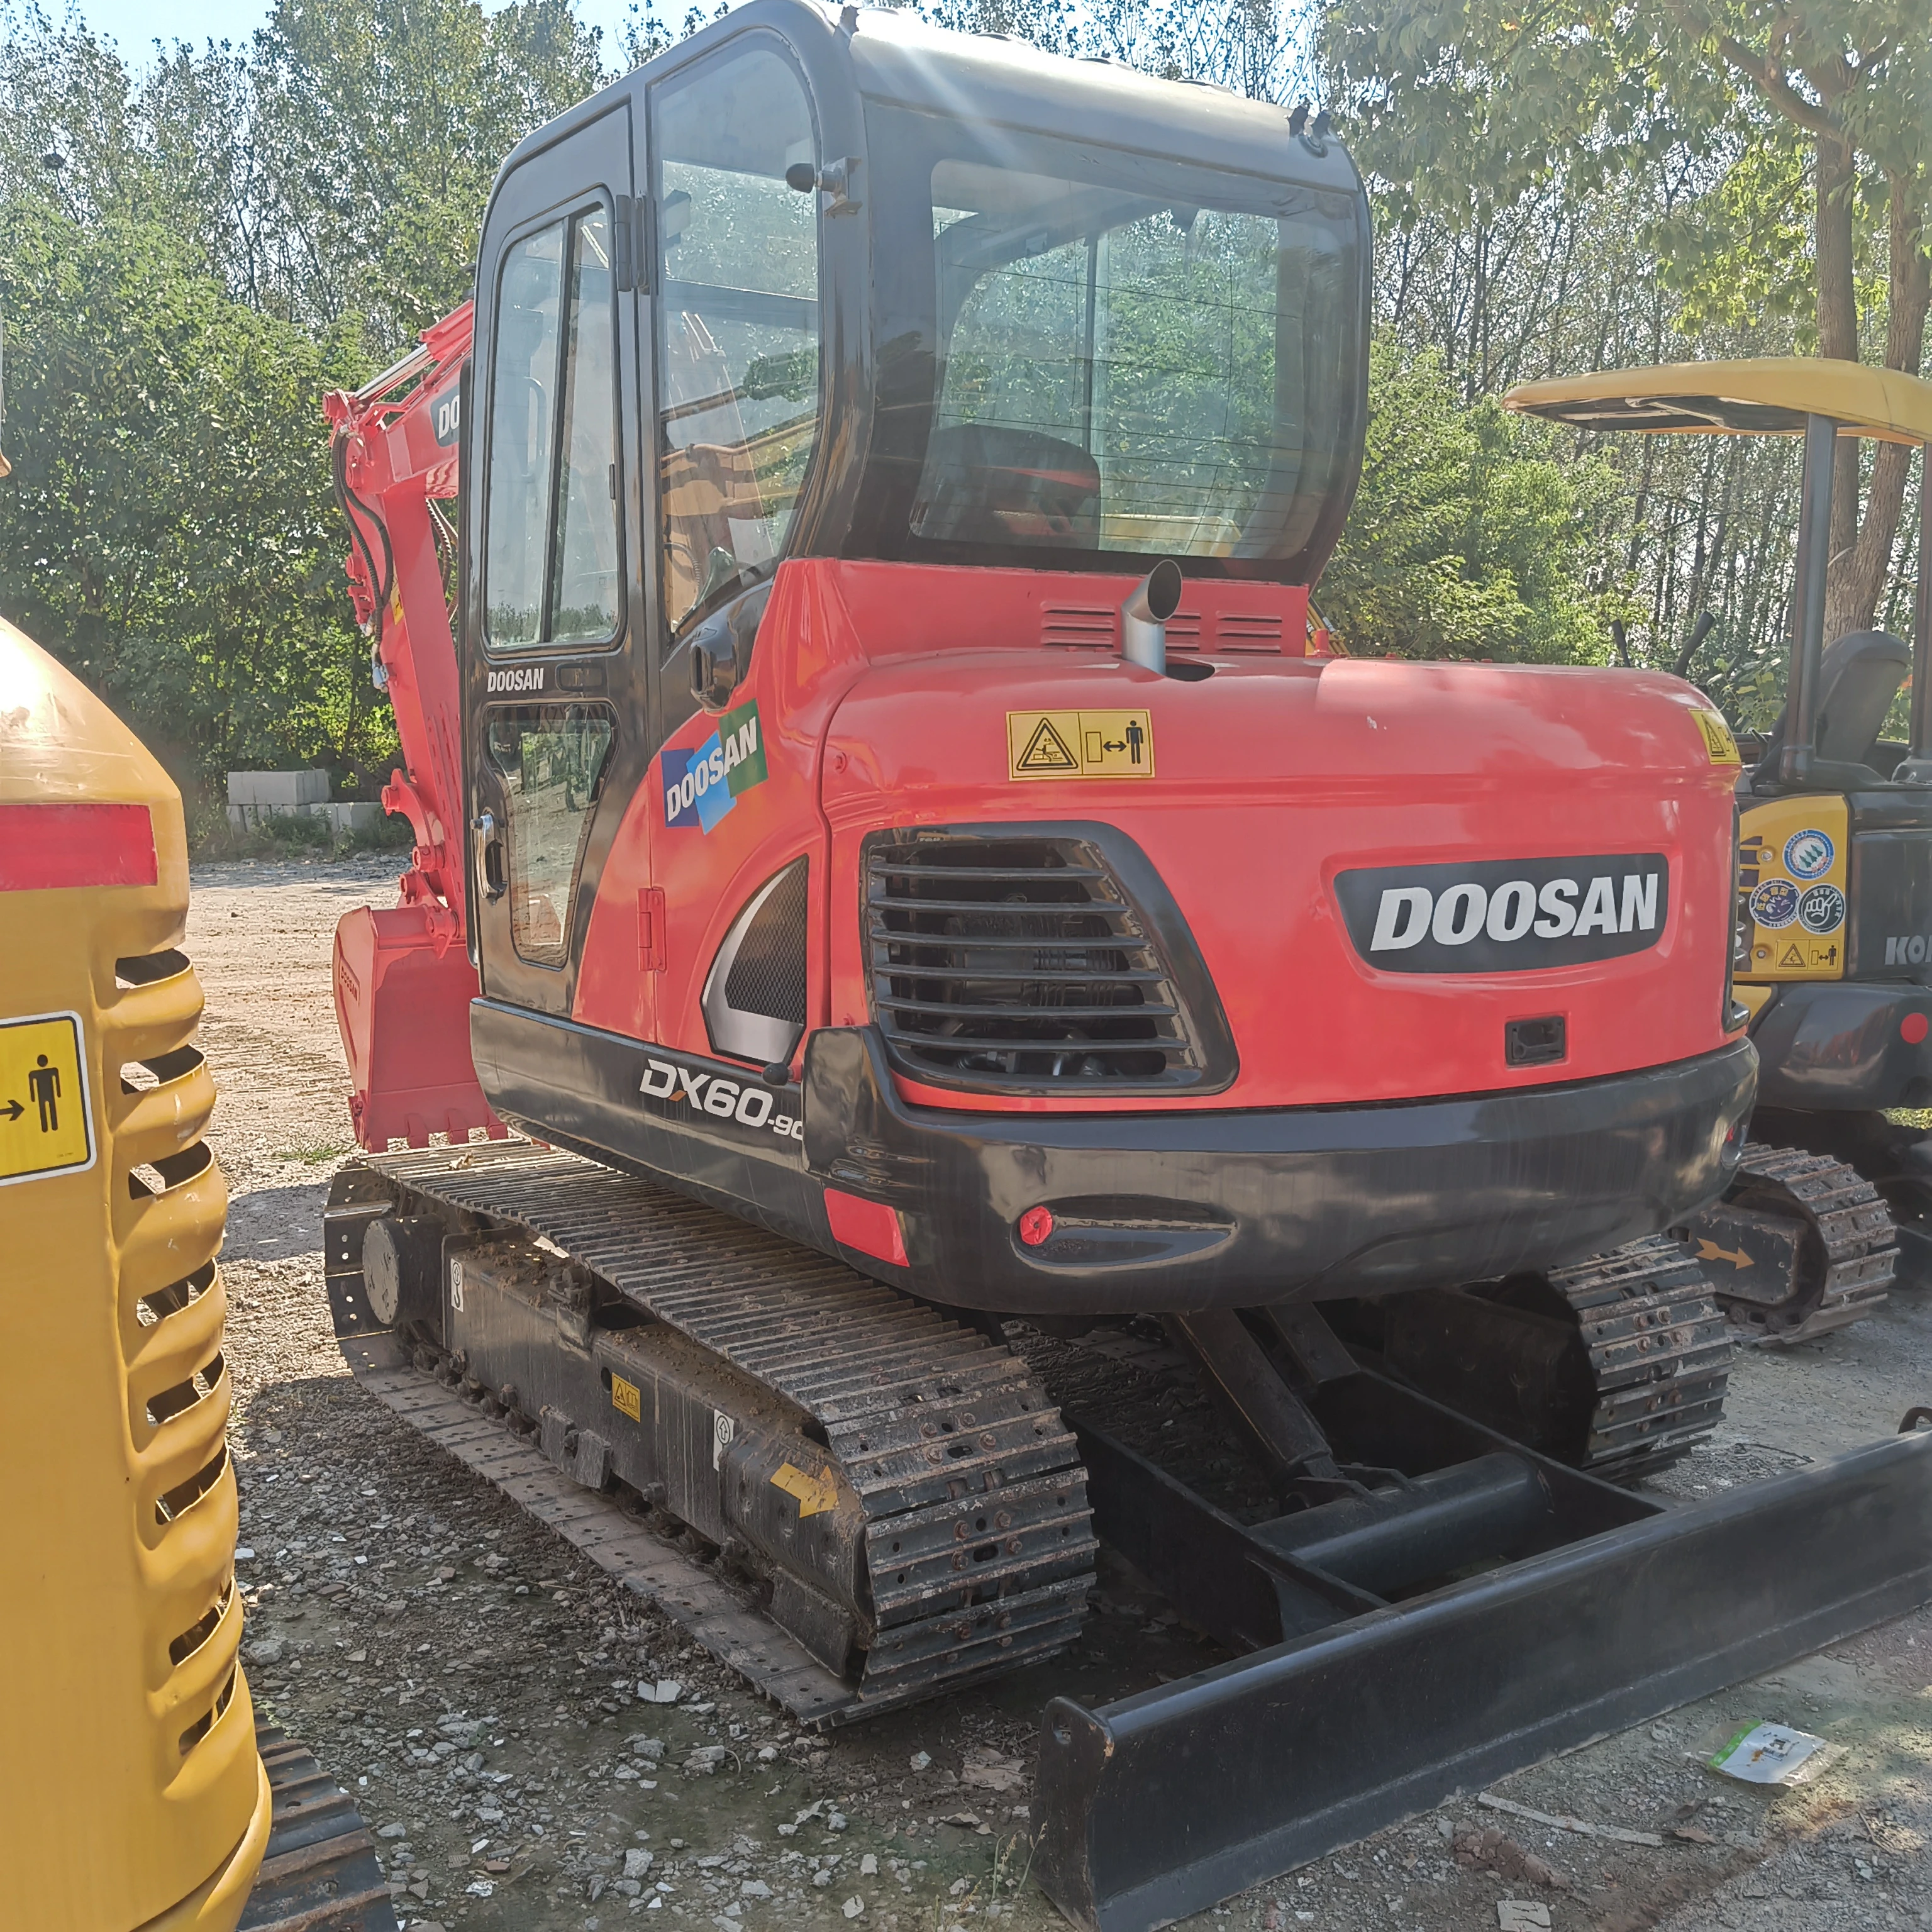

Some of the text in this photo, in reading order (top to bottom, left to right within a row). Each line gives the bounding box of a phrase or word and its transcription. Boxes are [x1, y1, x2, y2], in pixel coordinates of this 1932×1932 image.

[487, 668, 544, 692] DOOSAN
[667, 716, 757, 822] DOOSAN
[1370, 873, 1658, 951] DOOSAN
[341, 966, 357, 1001] DOOSAN
